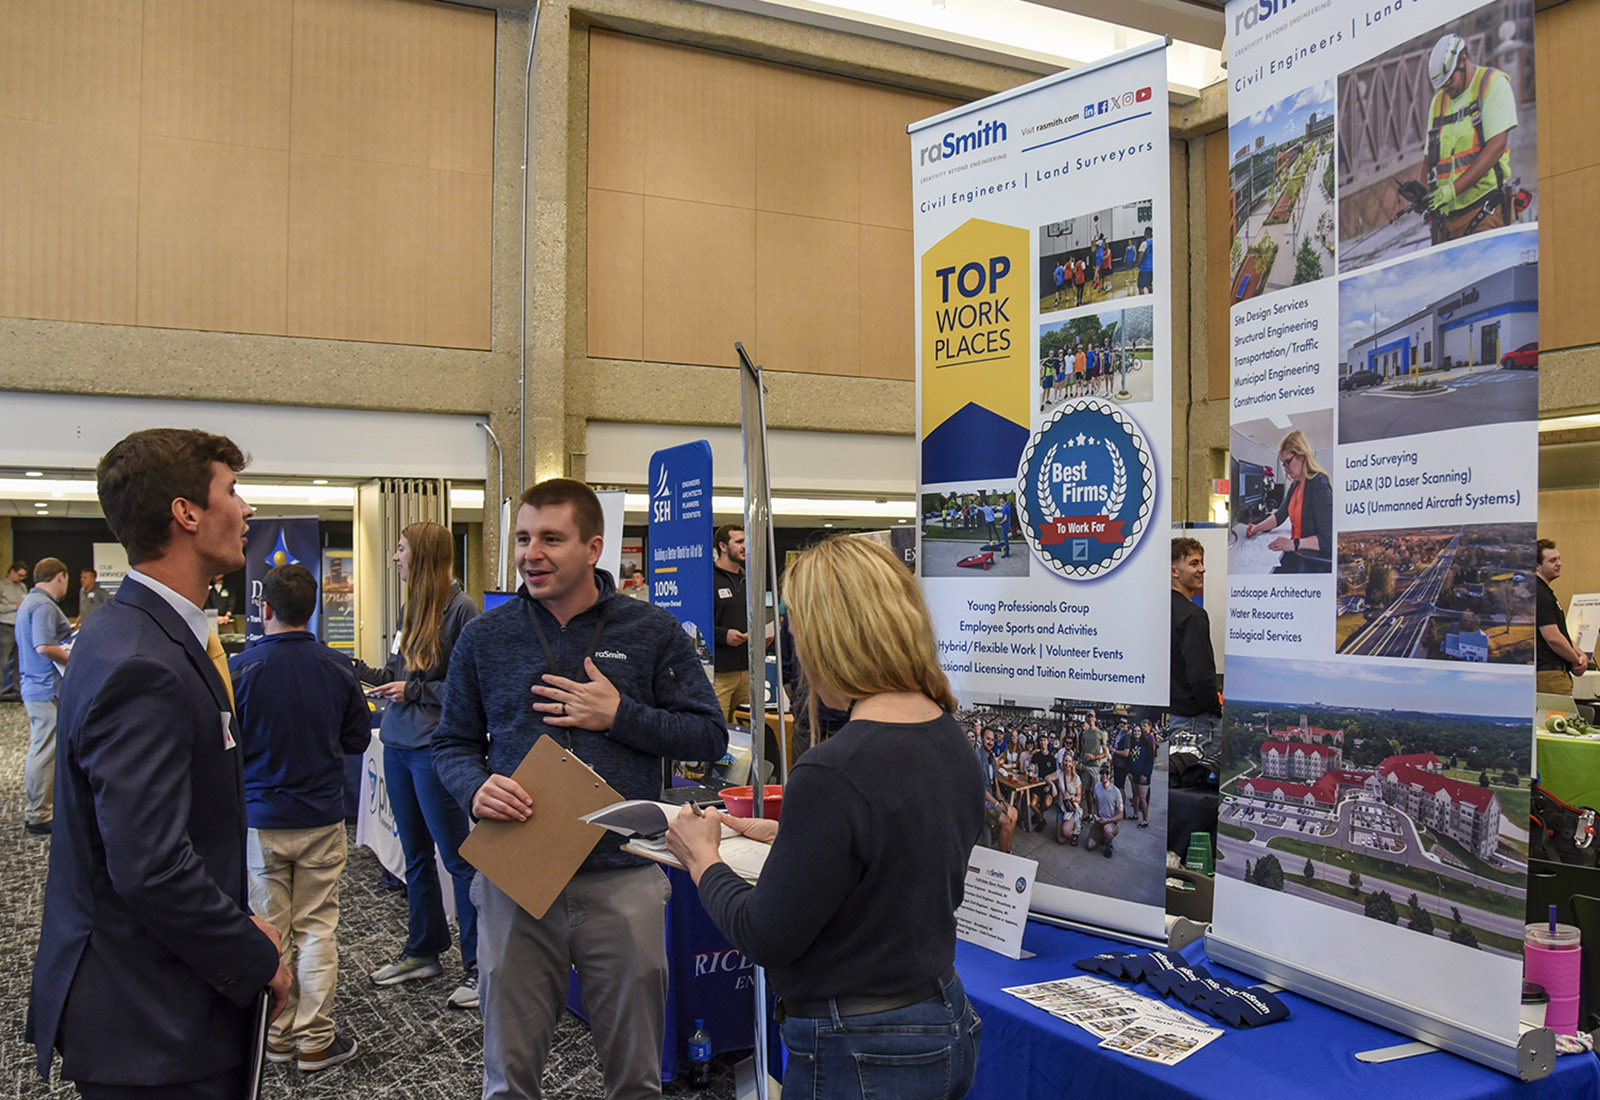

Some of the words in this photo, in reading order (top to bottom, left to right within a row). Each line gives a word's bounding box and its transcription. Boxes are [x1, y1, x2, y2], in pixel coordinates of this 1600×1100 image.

[1265, 23, 1288, 40] BEYOND
[1234, 66, 1264, 92] Civil
[1270, 31, 1343, 75] Engineers
[1021, 126, 1035, 136] Visit
[1036, 113, 1080, 132] rasmith.com
[920, 119, 1008, 167] raSmith
[920, 170, 947, 184] CREATIVITY
[948, 164, 969, 176] BEYOND
[970, 153, 1008, 169] ENGINEERING
[920, 195, 947, 213] Civil
[952, 178, 1017, 203] Engineers
[1036, 161, 1070, 182] Land
[1076, 141, 1153, 171] Surveyors
[935, 255, 1011, 304] TOP
[935, 296, 1011, 334] WORK
[1234, 314, 1245, 327] Site
[1246, 307, 1272, 323] Design
[1273, 299, 1309, 315] Services
[1234, 327, 1266, 347] Structural
[1267, 318, 1319, 338] Engineering
[935, 328, 1011, 361] PLACES
[1234, 338, 1319, 367] Transportation/Traffic
[1234, 369, 1267, 387] Municipal
[1268, 362, 1320, 381] Engineering
[1233, 391, 1277, 408] Construction
[1278, 385, 1315, 400] Services
[1345, 455, 1368, 469] Land
[1370, 450, 1418, 467] Surveying
[1052, 461, 1087, 483] Best
[1345, 478, 1373, 492] LiDAR
[1375, 476, 1392, 491] (3D
[1394, 474, 1420, 488] Laser
[1422, 467, 1472, 486] Scanning)
[1062, 483, 1109, 503] Firms
[1345, 501, 1366, 515] UAS
[1368, 497, 1424, 516] (Unmanned
[1425, 492, 1463, 509] Aircraft
[1465, 489, 1521, 510] Systems)
[653, 499, 671, 523] SEH
[1056, 523, 1066, 534] To
[1068, 522, 1090, 533] Work
[1091, 521, 1106, 532] For
[654, 580, 679, 597] 100%
[1230, 586, 1268, 600] Landscape
[1270, 586, 1322, 599] Architecture
[967, 600, 996, 615] Young
[998, 600, 1057, 614] Professionals
[1059, 601, 1090, 616] Group
[1229, 607, 1251, 619] Water
[1252, 608, 1294, 620] Resources
[959, 620, 1004, 636] Employee
[1006, 621, 1035, 636] Sports
[1036, 623, 1055, 635] and
[1057, 623, 1098, 636] Activities
[1229, 628, 1265, 643] Ecological
[1266, 629, 1302, 643] Services
[595, 650, 627, 660] raSmith
[938, 640, 1009, 654] Hybrid/Flexible
[1010, 643, 1036, 656] Work
[1046, 645, 1091, 659] Volunteer
[1093, 648, 1124, 661] Events
[974, 662, 1015, 678] Licensing
[1017, 664, 1035, 677] and
[1036, 665, 1067, 679] Tuition
[1069, 667, 1146, 684] Reimbursement
[1239, 991, 1270, 1014] raSmith
